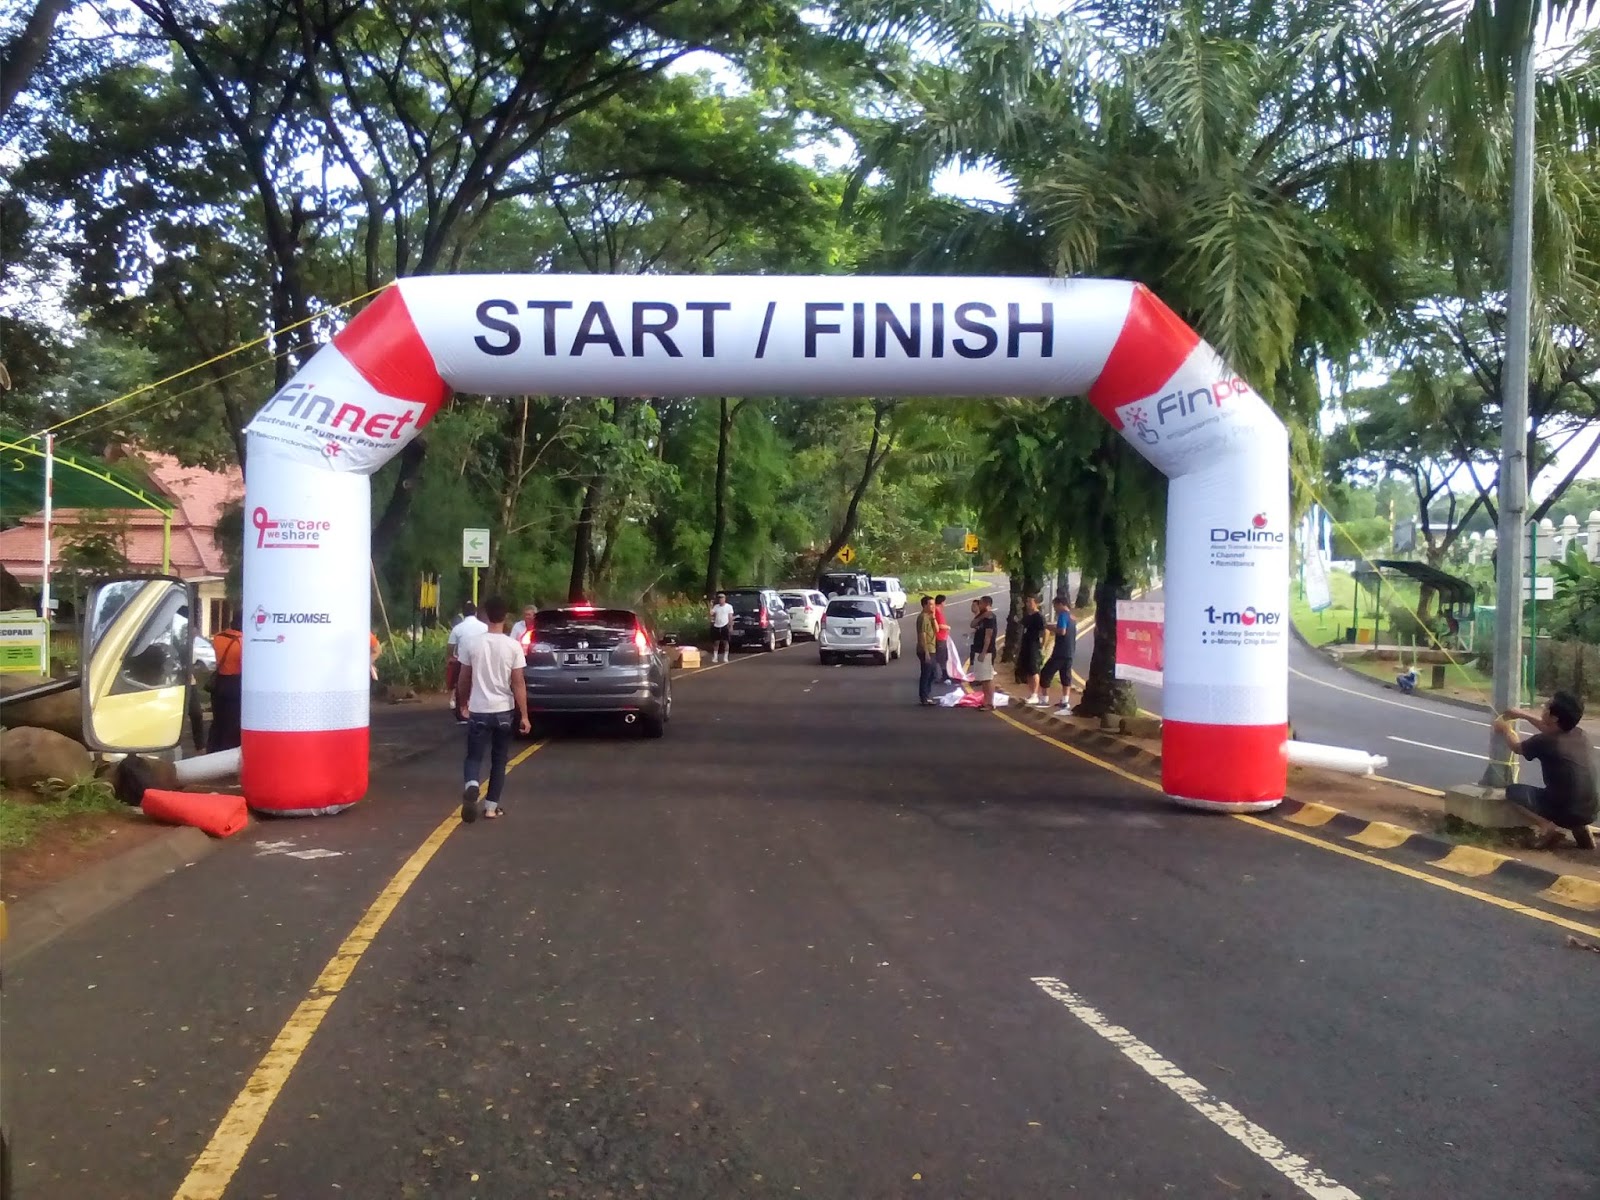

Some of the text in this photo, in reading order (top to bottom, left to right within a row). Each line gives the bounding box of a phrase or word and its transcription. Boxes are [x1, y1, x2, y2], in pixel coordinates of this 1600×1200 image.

[473, 298, 1054, 359] START / FINISH
[304, 425, 353, 443] Payment
[280, 521, 294, 529] we
[297, 520, 331, 531] care
[281, 530, 320, 541] share
[1210, 528, 1284, 542] Delima
[272, 613, 332, 624] TELKOMSEL
